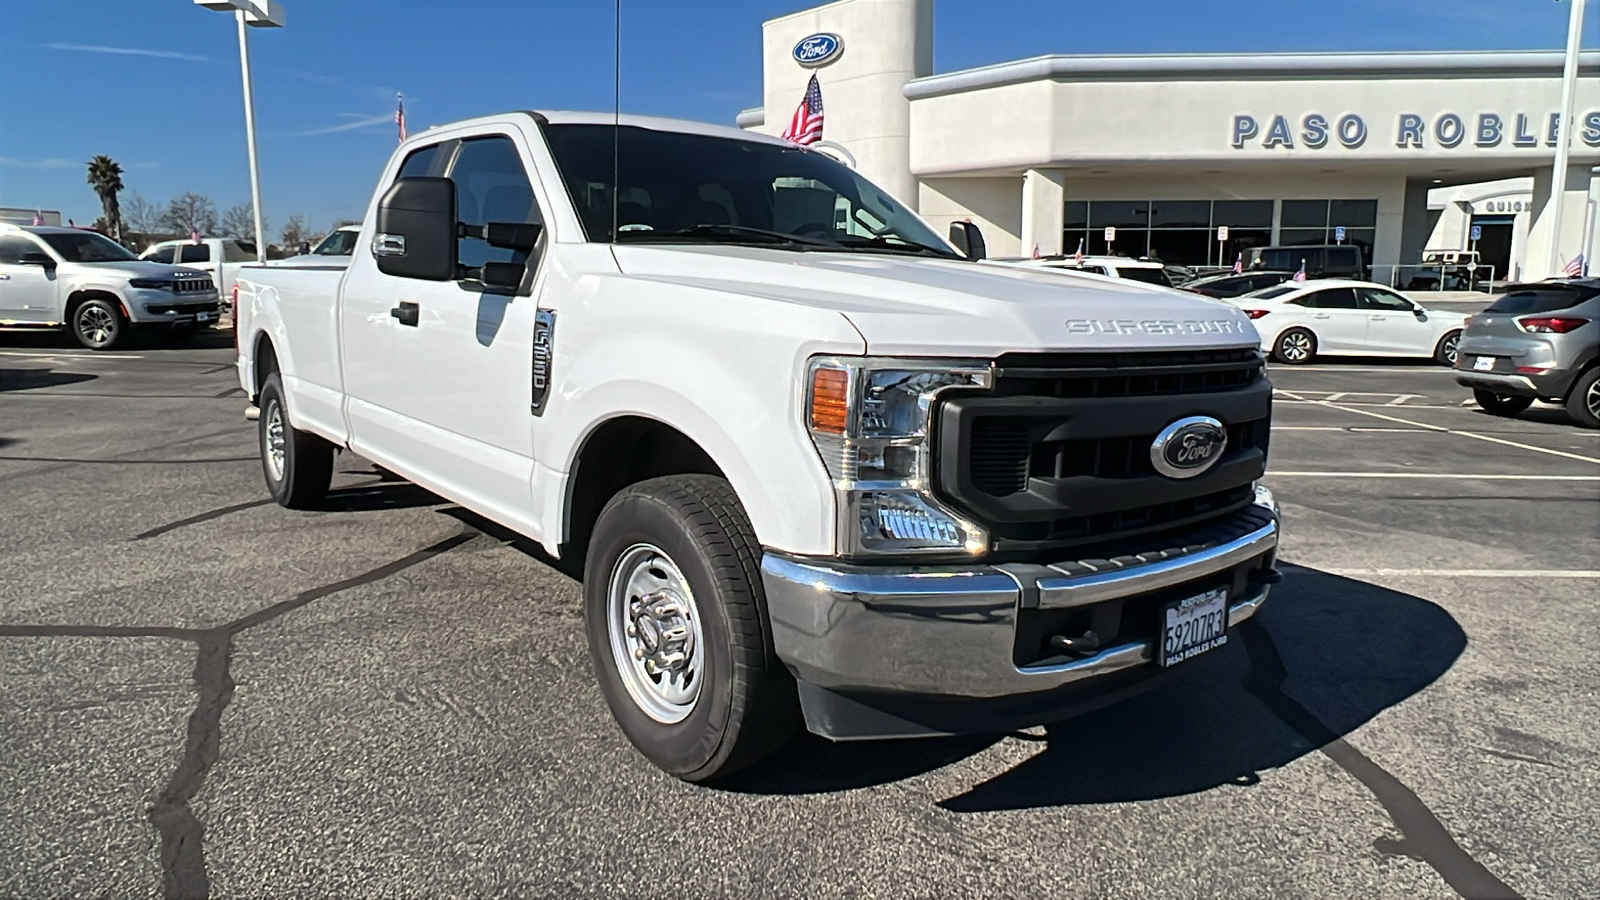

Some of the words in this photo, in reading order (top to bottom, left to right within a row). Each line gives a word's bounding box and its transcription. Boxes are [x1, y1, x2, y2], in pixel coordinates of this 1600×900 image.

[800, 39, 829, 59] Ford
[1232, 113, 1368, 149] PASO
[1177, 433, 1214, 462] Ford
